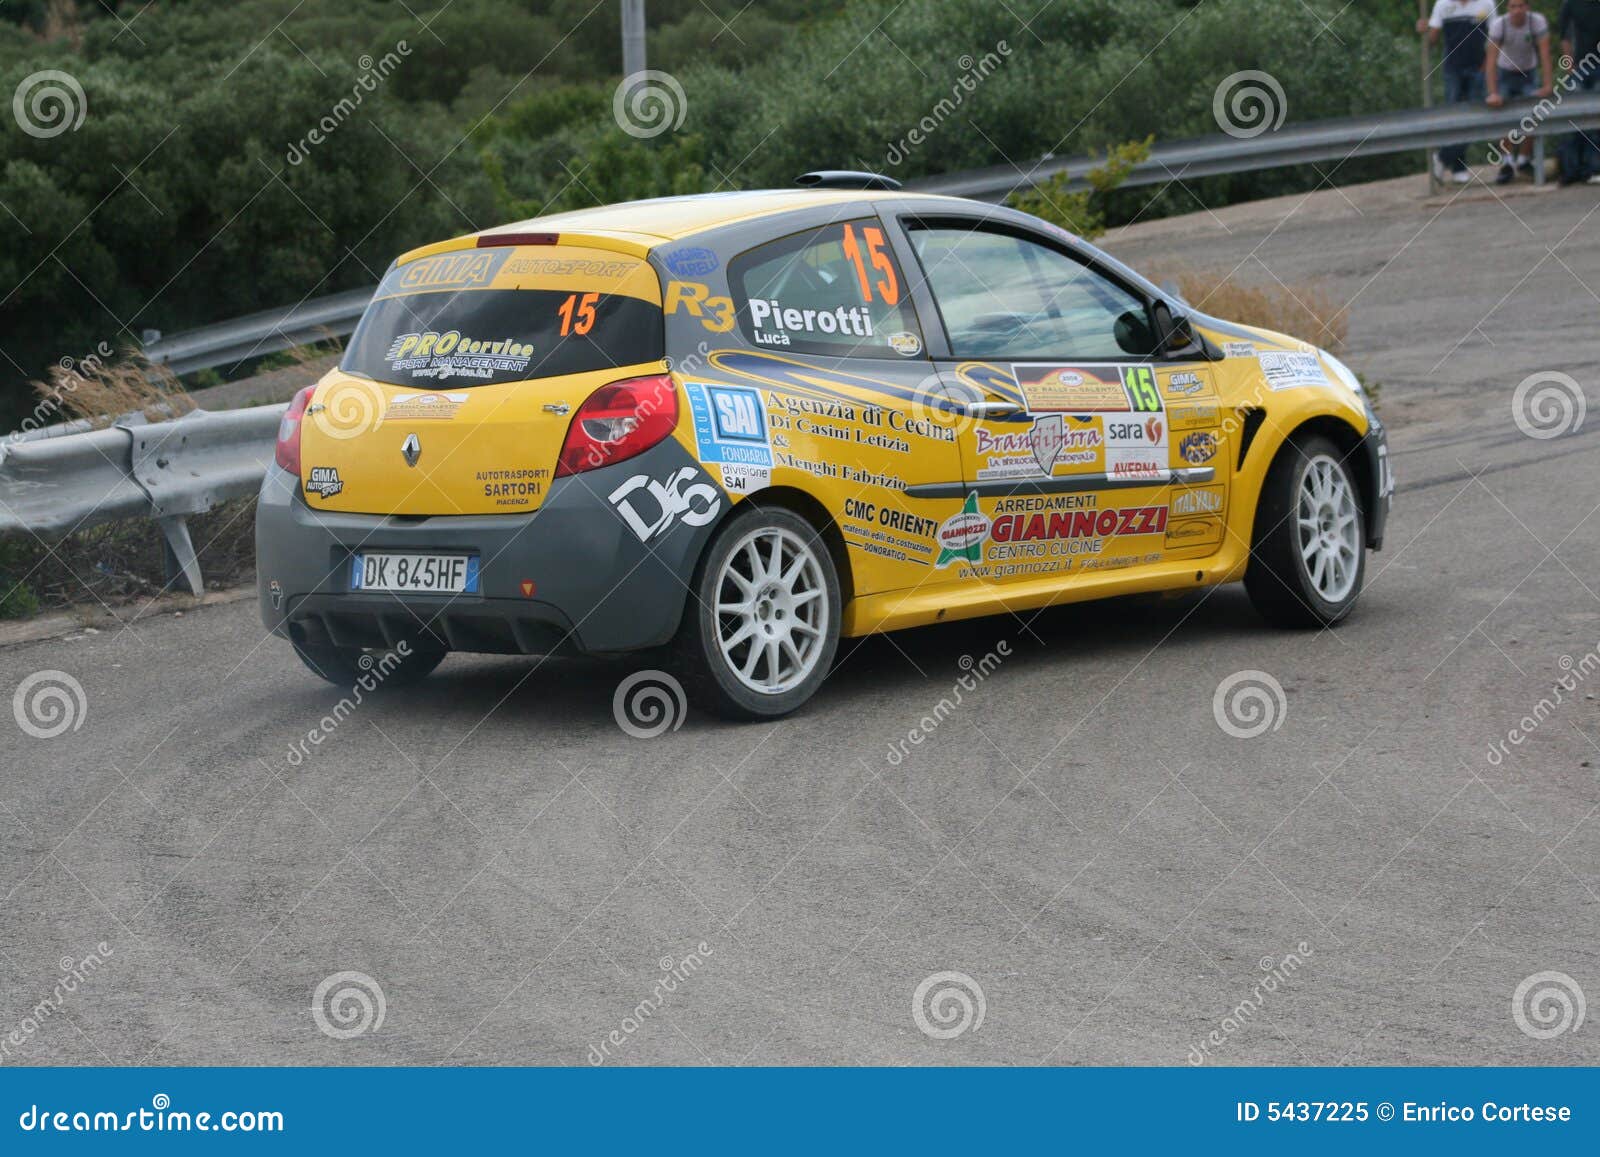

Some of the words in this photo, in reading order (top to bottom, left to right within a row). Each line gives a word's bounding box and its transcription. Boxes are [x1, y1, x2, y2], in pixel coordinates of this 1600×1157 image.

[401, 252, 495, 288] GIMA
[501, 258, 640, 279] AUTOSPORT
[842, 223, 899, 306] 15
[558, 292, 600, 337] 15
[664, 280, 737, 333] R3
[749, 298, 874, 337] Pierotti
[393, 330, 461, 360] PRO
[391, 358, 431, 371] SPORT
[430, 355, 529, 372] MANAGEMENT
[1126, 366, 1159, 412] 15
[1169, 373, 1198, 385] GIMA
[687, 385, 711, 445] GRUPPO
[715, 392, 760, 436] SAI
[767, 391, 856, 421] Agenzia
[862, 405, 882, 426] di
[888, 410, 956, 442] Cecina
[770, 415, 791, 429] Di
[797, 419, 850, 440] Casini
[856, 430, 911, 453] Letizia
[773, 435, 789, 447] &
[975, 424, 1102, 454] Brandibirra
[1109, 423, 1143, 440] sara
[720, 446, 771, 465] FONDIARIA
[311, 468, 339, 482] GIMA
[476, 469, 550, 481] AUTOTRASPORTI
[722, 465, 768, 478] divisione
[775, 452, 837, 478] Menghi
[842, 466, 908, 491] Fabrizio
[1113, 462, 1159, 478] AVERNA
[306, 481, 323, 490] AUTO
[321, 481, 344, 498] SPORT
[484, 482, 541, 497] SARTORI
[725, 476, 746, 489] SAI
[496, 498, 529, 506] PIACENZA
[995, 494, 1097, 513] ARREDAMENTI
[845, 498, 876, 522] CMC
[879, 507, 939, 539] ORIENTI
[990, 505, 1169, 543] GIANNOZZI
[843, 524, 871, 537] materiali
[886, 535, 895, 544] da
[896, 539, 933, 554] costruzione
[941, 523, 987, 540] GIANNOZZI
[864, 542, 907, 561] DONORATICO
[987, 543, 1046, 560] CENTRO
[1050, 539, 1102, 554] CUCINE
[364, 556, 390, 587] DK
[397, 557, 465, 589] 845HF
[959, 557, 1072, 579] www.giannozzi.it
